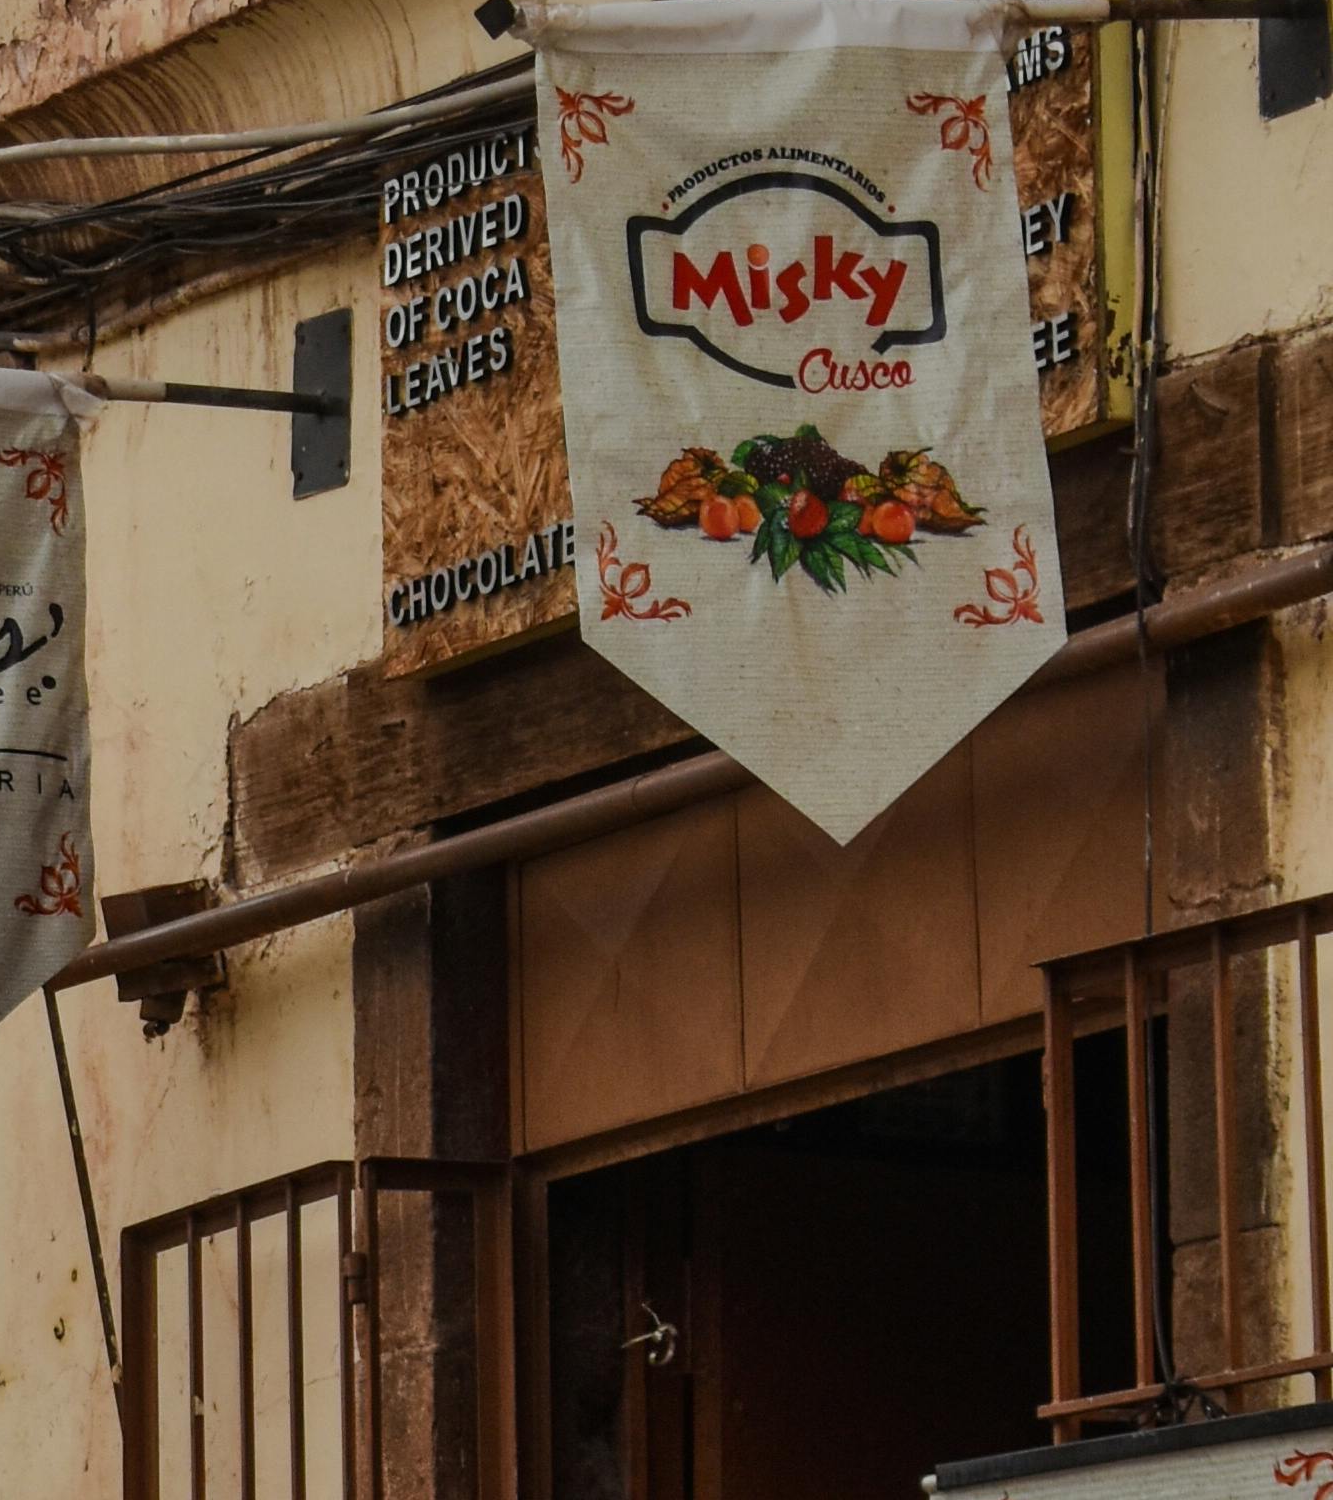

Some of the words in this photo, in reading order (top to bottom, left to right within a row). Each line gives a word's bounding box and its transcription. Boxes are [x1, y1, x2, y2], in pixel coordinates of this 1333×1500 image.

[1007, 28, 1065, 93] MS
[384, 133, 541, 223] PRODUCT
[667, 149, 764, 203] PRODUCTOS
[766, 147, 887, 203] ALIMENTARIOS
[384, 193, 523, 287] DERIVED
[672, 235, 908, 328] Misky
[386, 305, 423, 349] OF
[435, 258, 524, 333] COCA
[387, 327, 508, 415] LEAVES
[798, 348, 916, 393] Cusco
